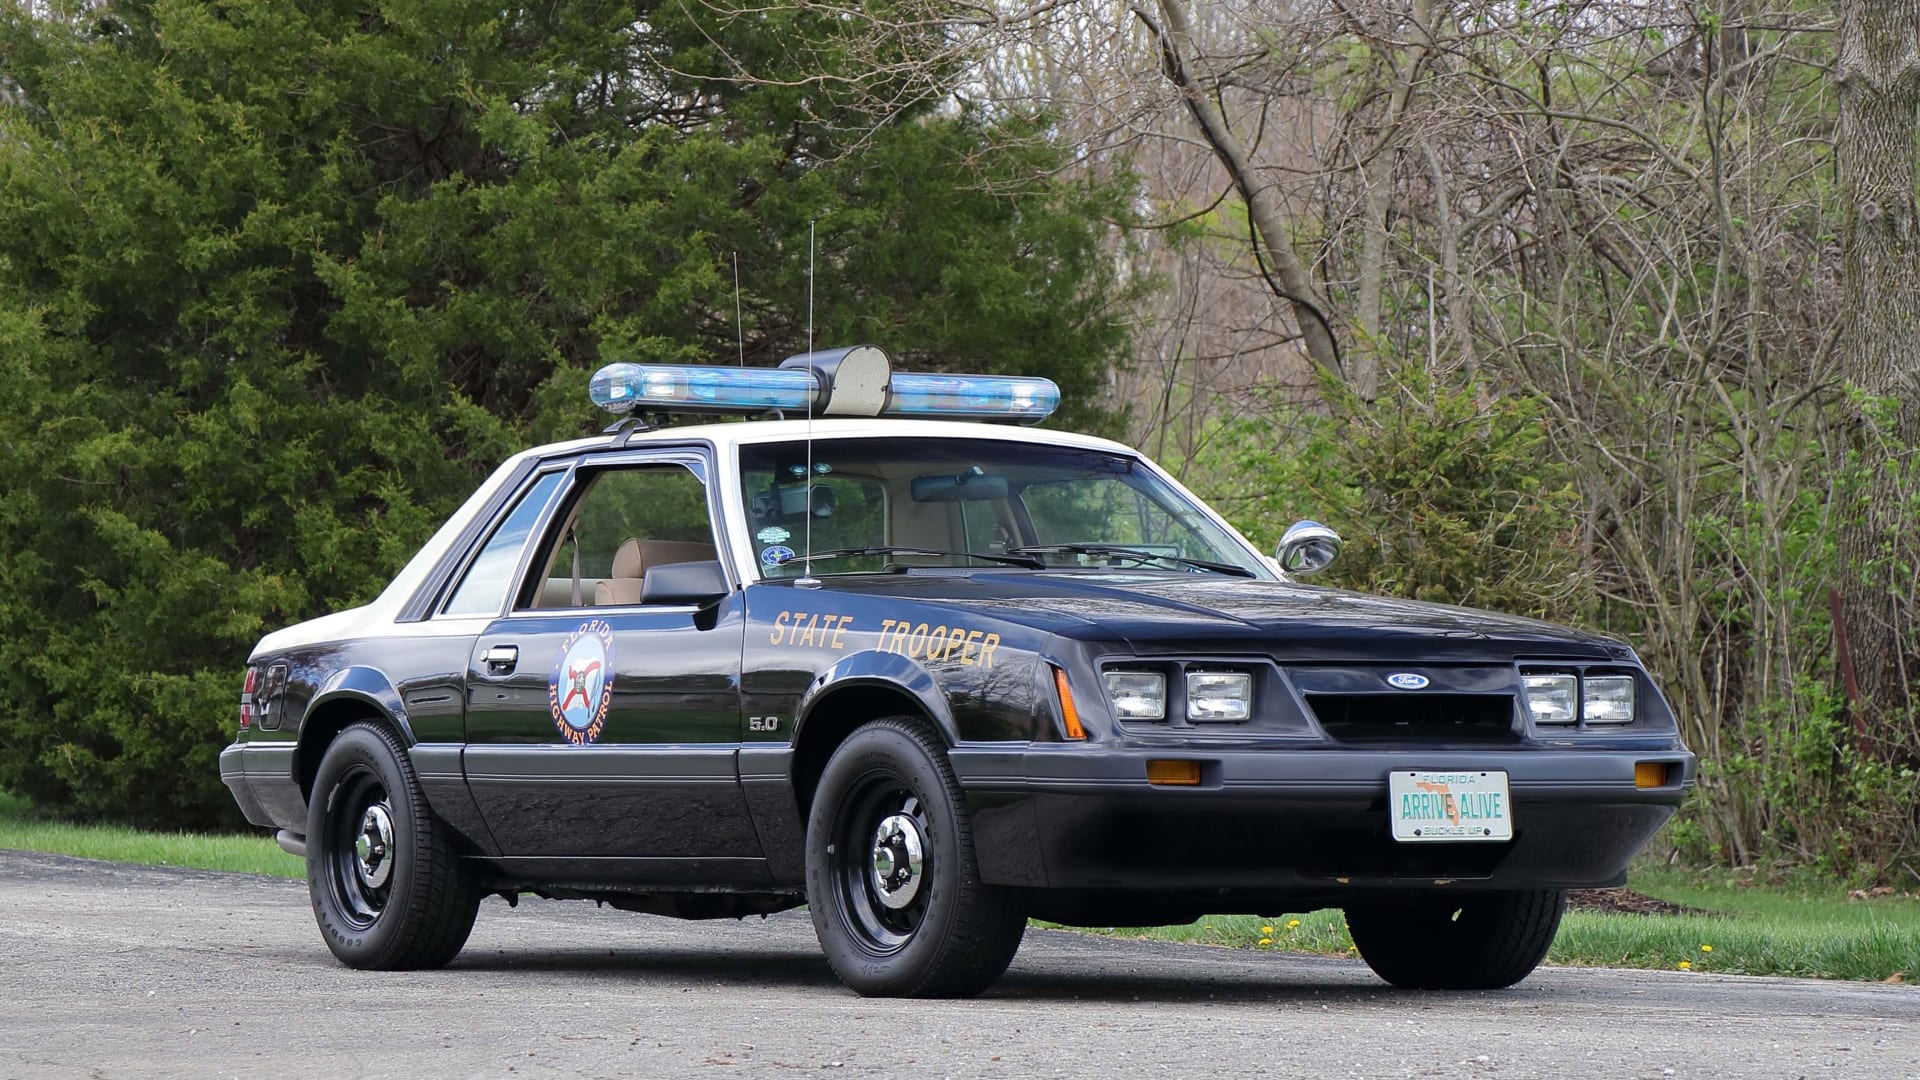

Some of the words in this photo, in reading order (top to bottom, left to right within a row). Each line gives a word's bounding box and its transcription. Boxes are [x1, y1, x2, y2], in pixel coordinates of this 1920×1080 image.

[561, 620, 614, 653] FLORIDA
[770, 611, 854, 649] STATE
[875, 619, 1000, 669] TROOPER
[548, 683, 585, 746] HIGHWAY
[587, 681, 613, 743] PATROL
[749, 716, 779, 731] 5.0
[1423, 775, 1475, 784] FLORIDA
[1402, 793, 1454, 820] ARRIVE
[1460, 793, 1502, 819] ALIVE
[1423, 827, 1465, 836] BUCKLE
[1469, 827, 1482, 836] UP
